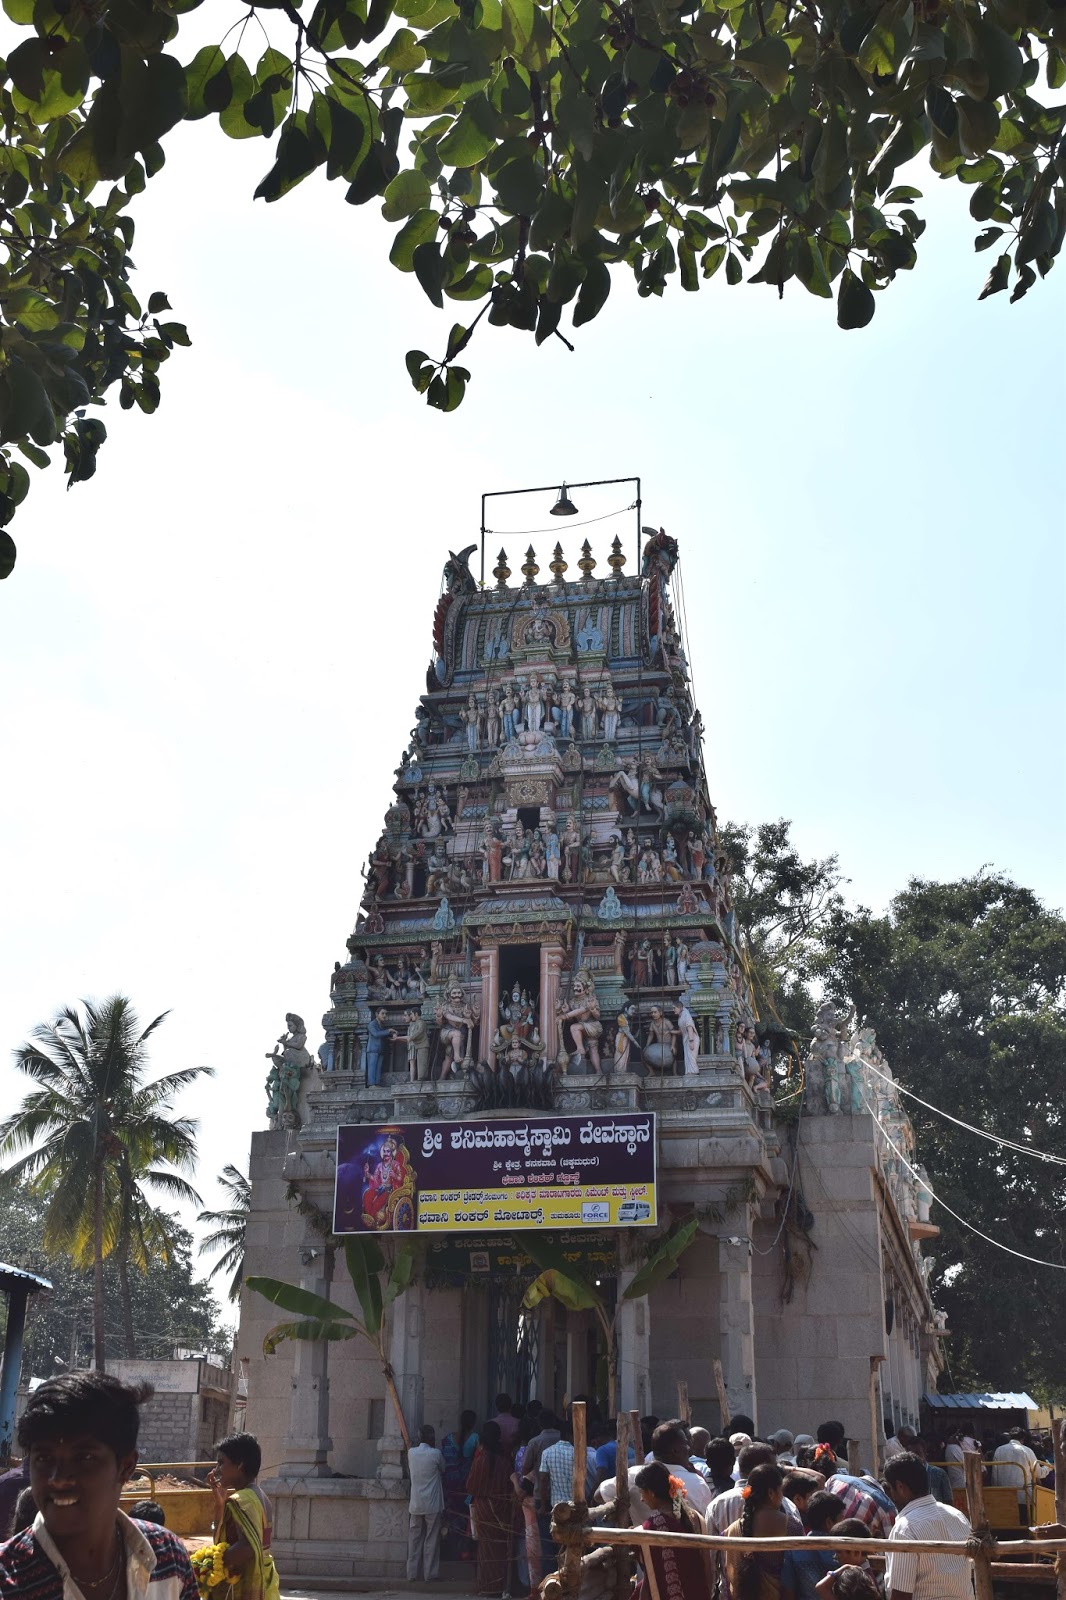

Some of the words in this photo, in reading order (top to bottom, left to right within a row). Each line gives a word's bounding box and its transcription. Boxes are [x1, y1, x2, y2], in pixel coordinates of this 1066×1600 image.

[421, 1128, 443, 1158] ಶ್ರೀ
[450, 1124, 571, 1157] ಶನಿಮಹಾತ್ಮಸ್ವಾಮಿ
[579, 1119, 650, 1156] ದೇವಸ್ಥಾನ
[492, 1160, 502, 1171] ಶ್ರೀ
[419, 1212, 449, 1225] ಭವಾನಿ
[454, 1210, 489, 1222] ಶಂಕರ್
